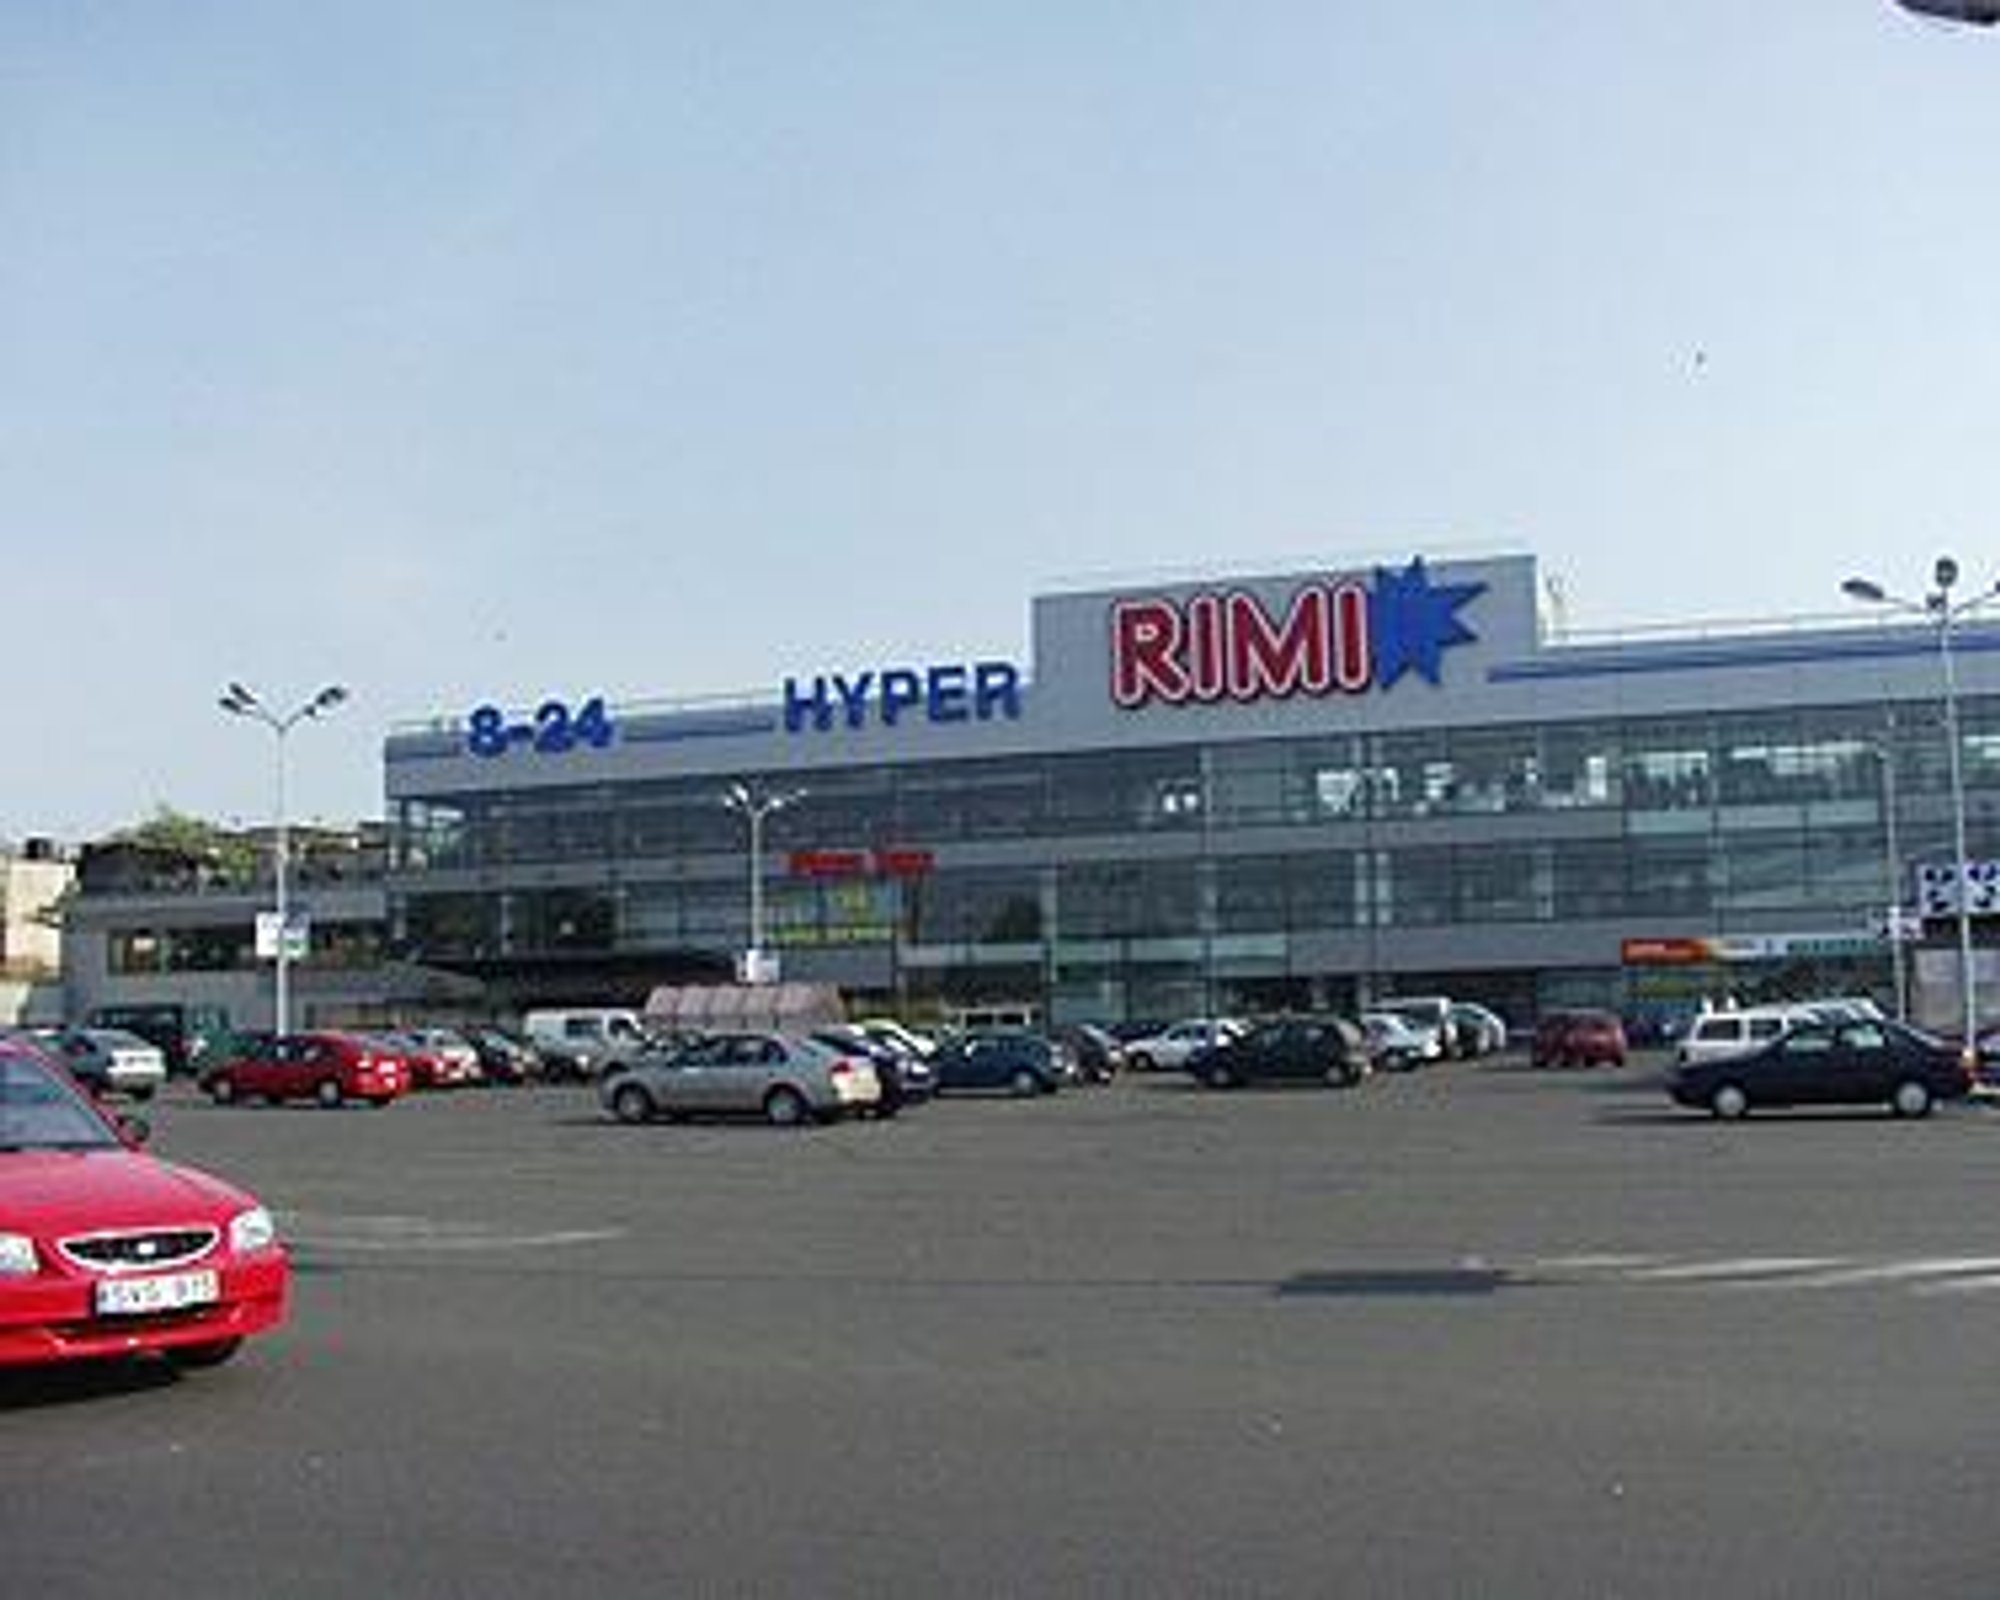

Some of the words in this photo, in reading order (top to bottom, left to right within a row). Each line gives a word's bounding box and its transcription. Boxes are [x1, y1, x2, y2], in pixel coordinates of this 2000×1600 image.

[783, 660, 1022, 733] HYPER
[1111, 579, 1373, 708] RIMI
[467, 697, 615, 758] 8-24
